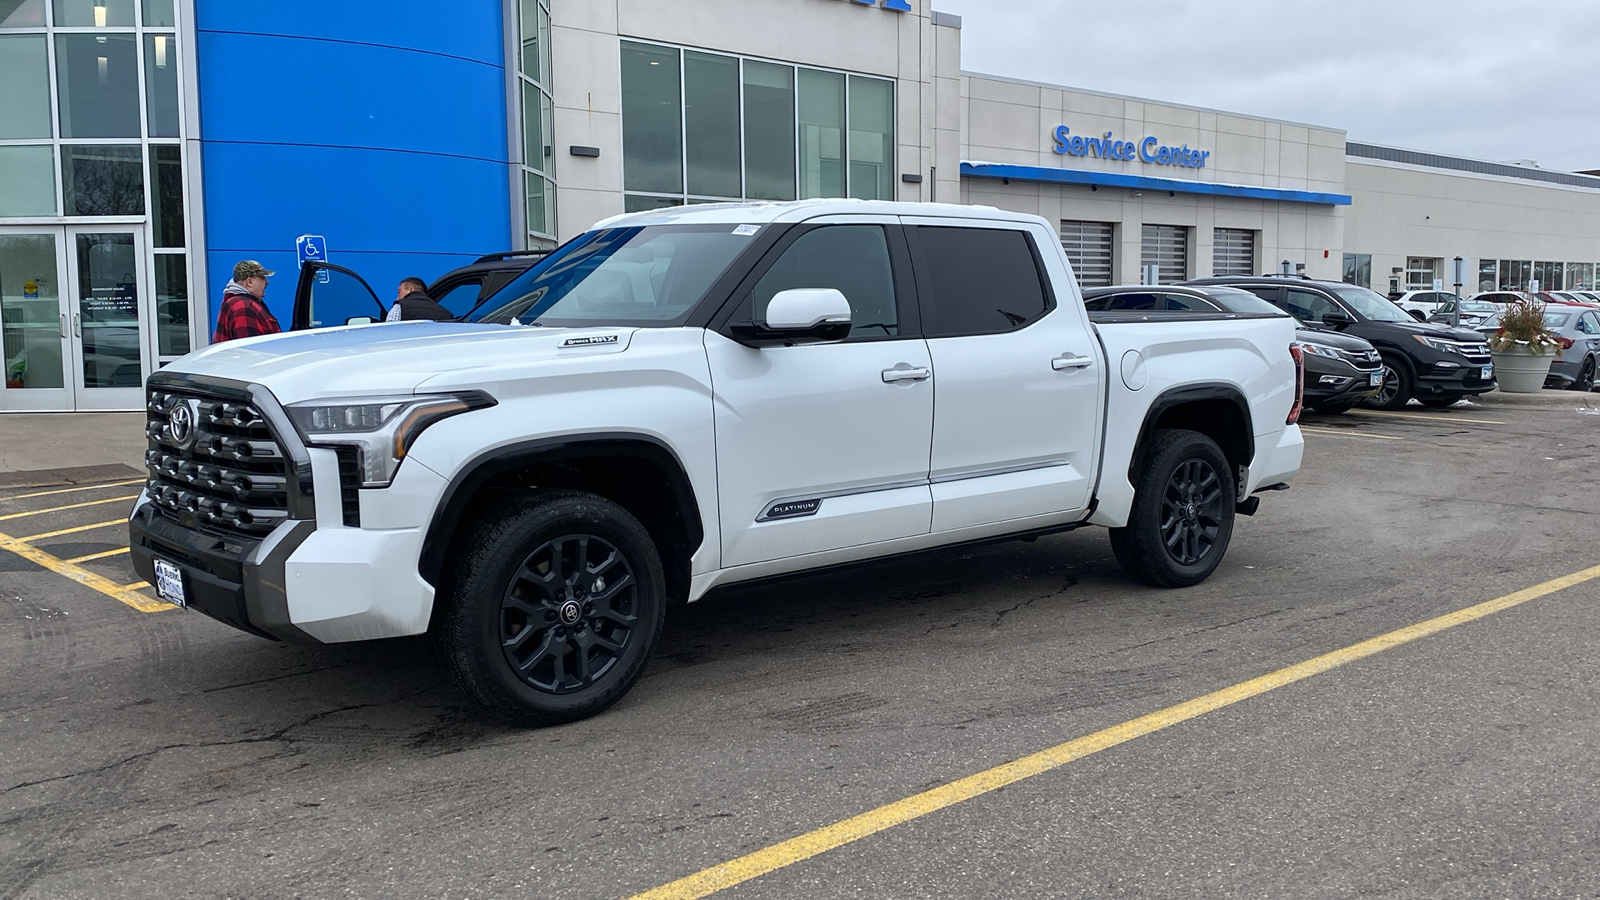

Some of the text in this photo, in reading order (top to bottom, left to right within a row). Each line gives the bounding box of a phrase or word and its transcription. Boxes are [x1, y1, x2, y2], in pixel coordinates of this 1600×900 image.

[1053, 124, 1210, 168] Service Center
[774, 503, 815, 513] PLATINUM
